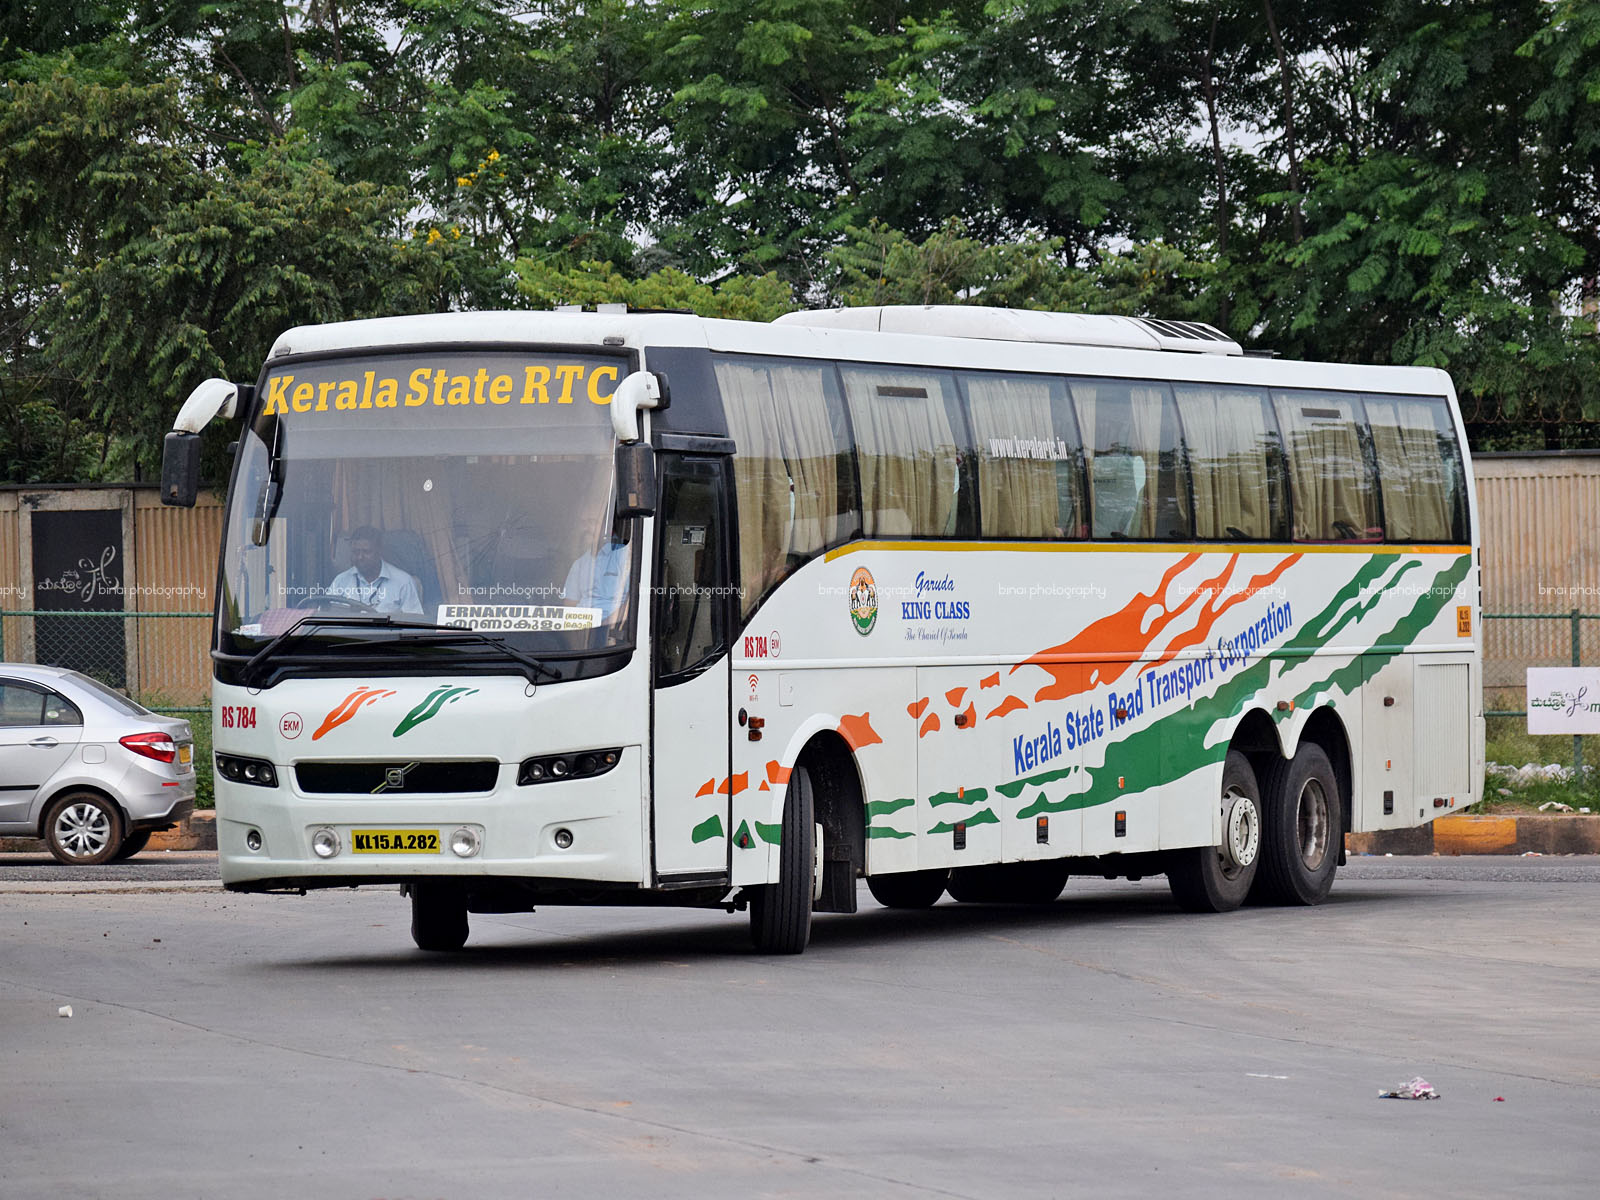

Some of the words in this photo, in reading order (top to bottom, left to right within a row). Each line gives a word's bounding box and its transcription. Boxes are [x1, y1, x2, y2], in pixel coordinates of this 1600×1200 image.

[262, 371, 397, 416] Kerala
[404, 368, 513, 407] State
[520, 365, 618, 405] RTC
[989, 435, 1068, 460] www.keralartc.in
[915, 571, 955, 598] Garuda
[445, 607, 564, 618] ERNAKULAM
[901, 601, 931, 620] KING
[935, 601, 970, 620] CLASS
[744, 636, 754, 658] RS
[755, 636, 768, 658] 784
[1013, 721, 1062, 775] Kerala
[1065, 703, 1104, 751] State
[1108, 678, 1144, 731] Road
[1146, 646, 1214, 709] Transport
[1217, 601, 1293, 672] Corporation
[222, 706, 234, 729] RS
[236, 706, 256, 729] 784
[283, 720, 300, 732] EKM
[355, 834, 437, 850] KL15.A.282
